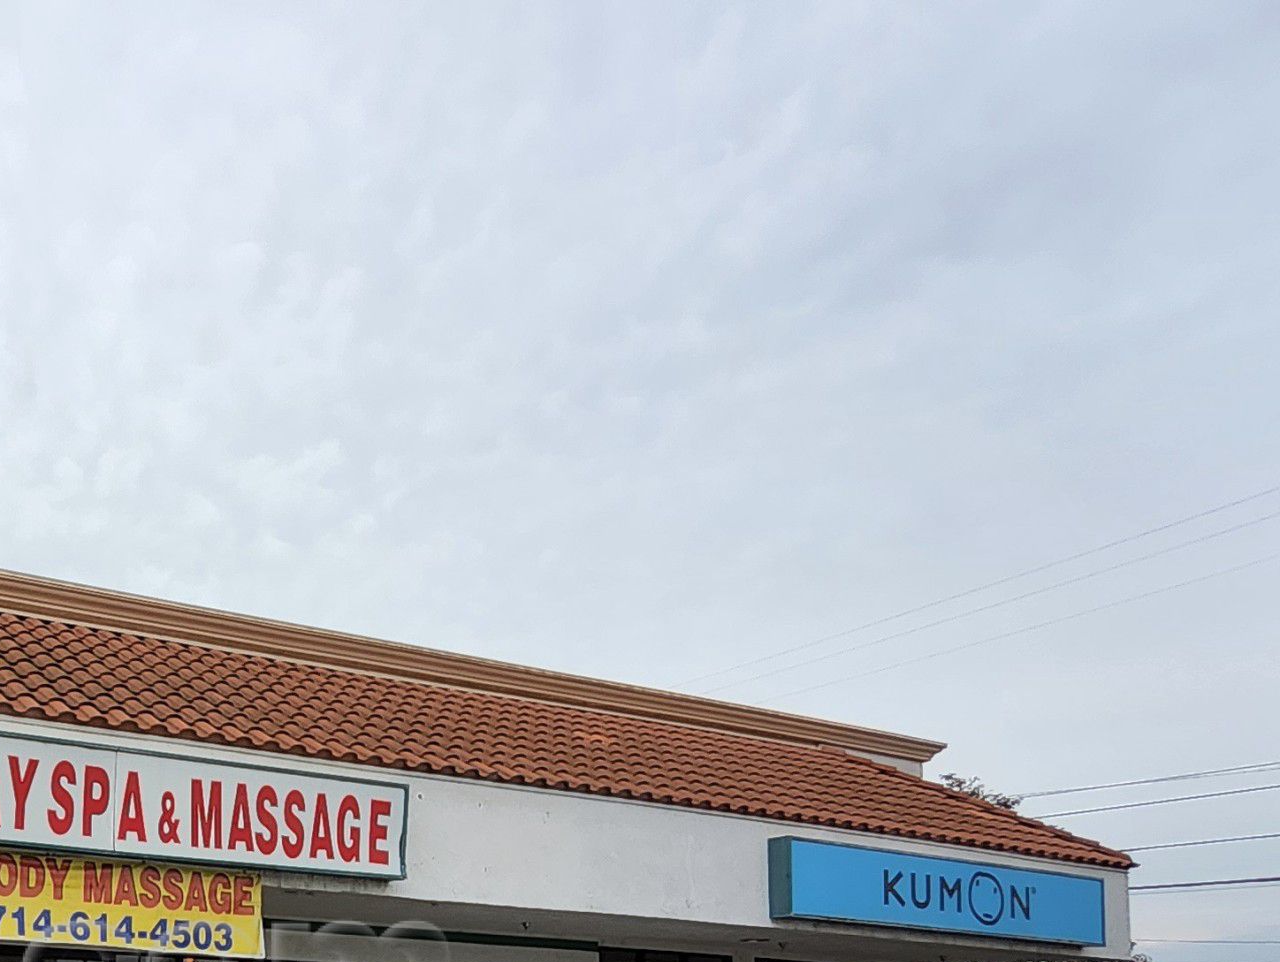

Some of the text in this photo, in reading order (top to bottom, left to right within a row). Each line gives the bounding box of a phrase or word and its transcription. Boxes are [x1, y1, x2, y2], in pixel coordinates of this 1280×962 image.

[47, 760, 148, 842] SPA
[158, 791, 181, 844] &
[191, 778, 392, 866] MASSAGE
[82, 861, 256, 916] MASSAGE
[883, 868, 1032, 927] KUMON
